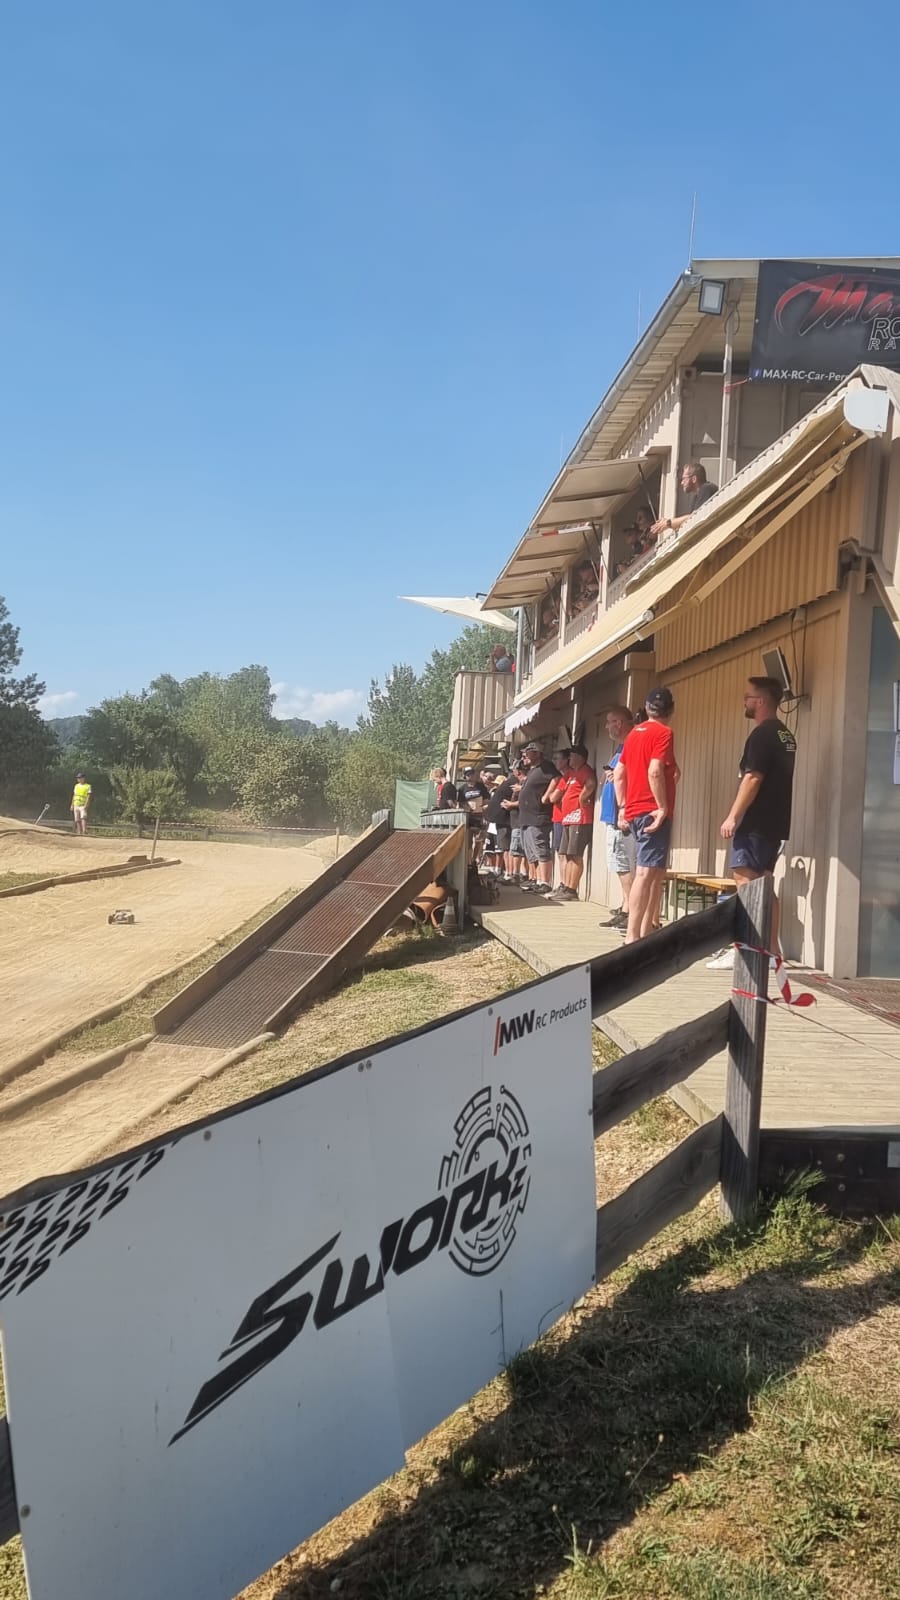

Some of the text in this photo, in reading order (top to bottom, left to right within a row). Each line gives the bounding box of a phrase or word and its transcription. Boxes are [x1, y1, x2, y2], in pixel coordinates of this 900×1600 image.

[774, 272, 900, 336] Ma
[867, 338, 898, 351] RA
[762, 369, 849, 381] MAX-RC-Car-Per
[535, 1013, 547, 1030] RC
[549, 998, 587, 1024] Products
